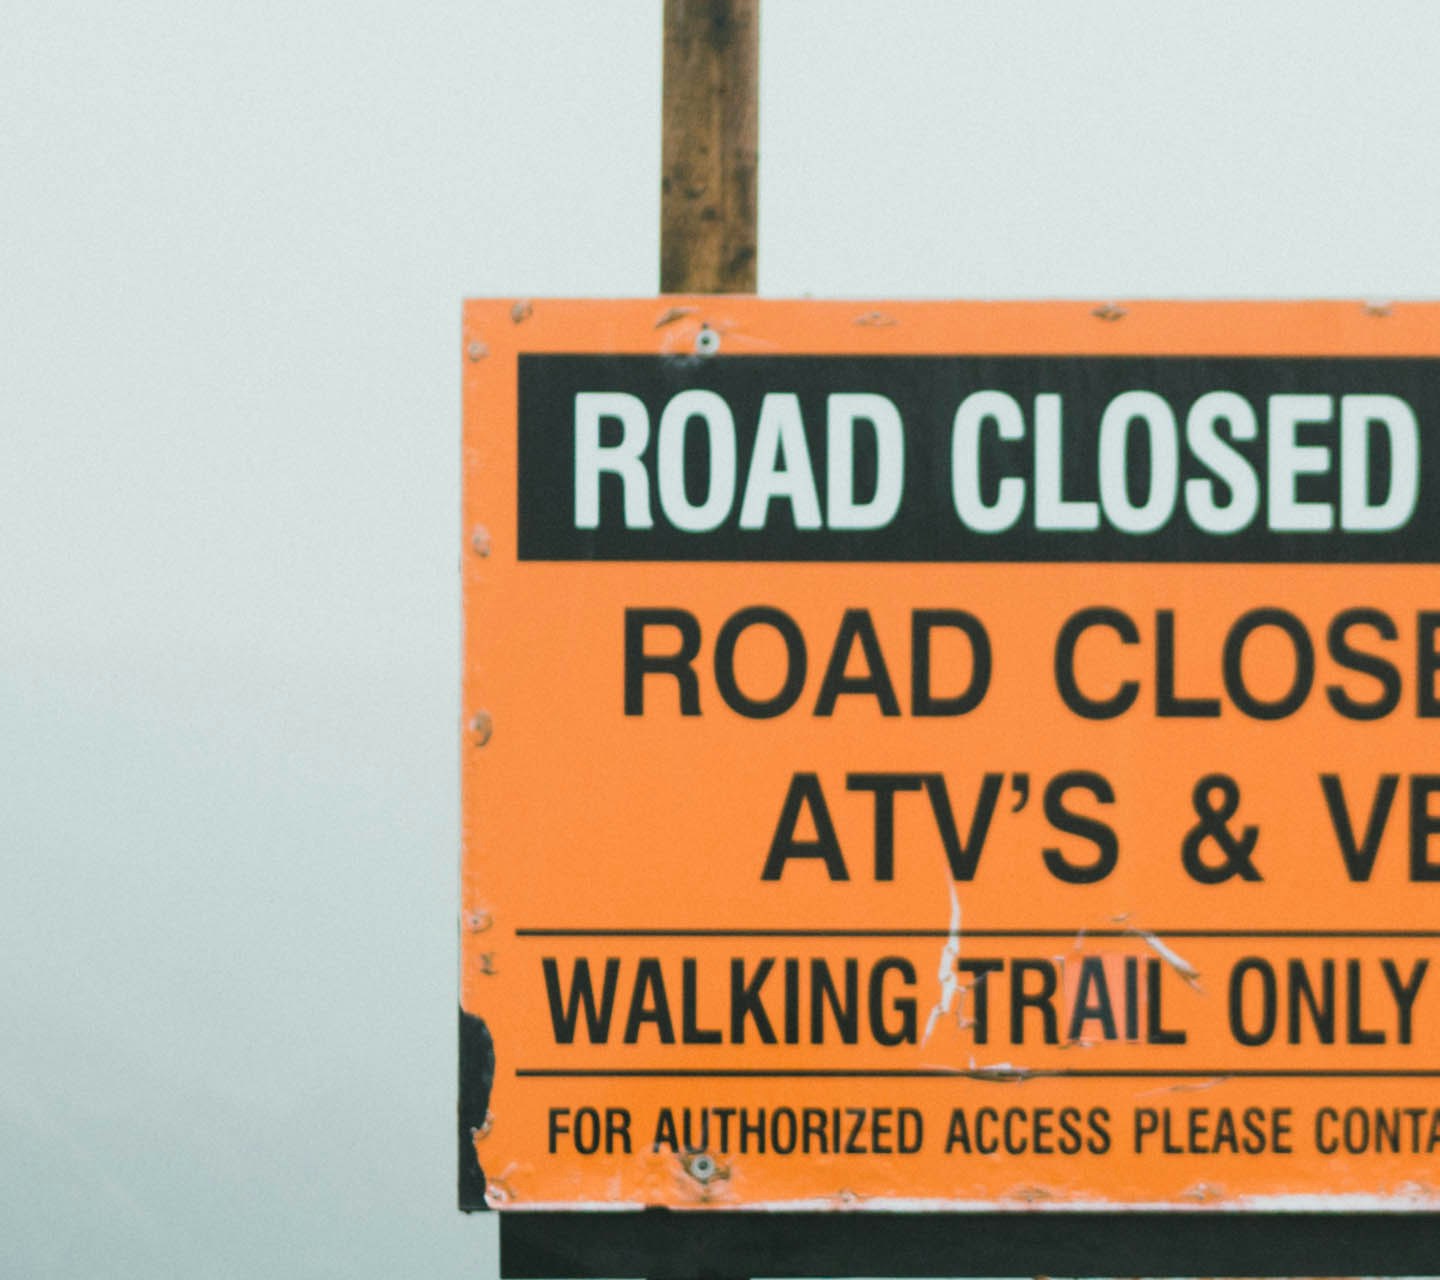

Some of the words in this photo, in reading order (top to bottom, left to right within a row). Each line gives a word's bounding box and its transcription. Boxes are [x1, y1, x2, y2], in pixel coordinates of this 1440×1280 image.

[575, 390, 904, 531] ROAD
[952, 390, 1418, 533] CLOSED
[623, 605, 993, 720] ROAD
[761, 770, 1119, 885] ATV'S
[1181, 774, 1263, 885] &
[542, 956, 918, 1047] WALKING
[957, 957, 1187, 1045] TRAIL
[1228, 957, 1429, 1047] ONLY
[548, 1107, 632, 1156] FOR
[653, 1107, 924, 1156] AUTHORIZED
[945, 1107, 1111, 1156] ACCESS
[1134, 1107, 1292, 1155] PLEASE
